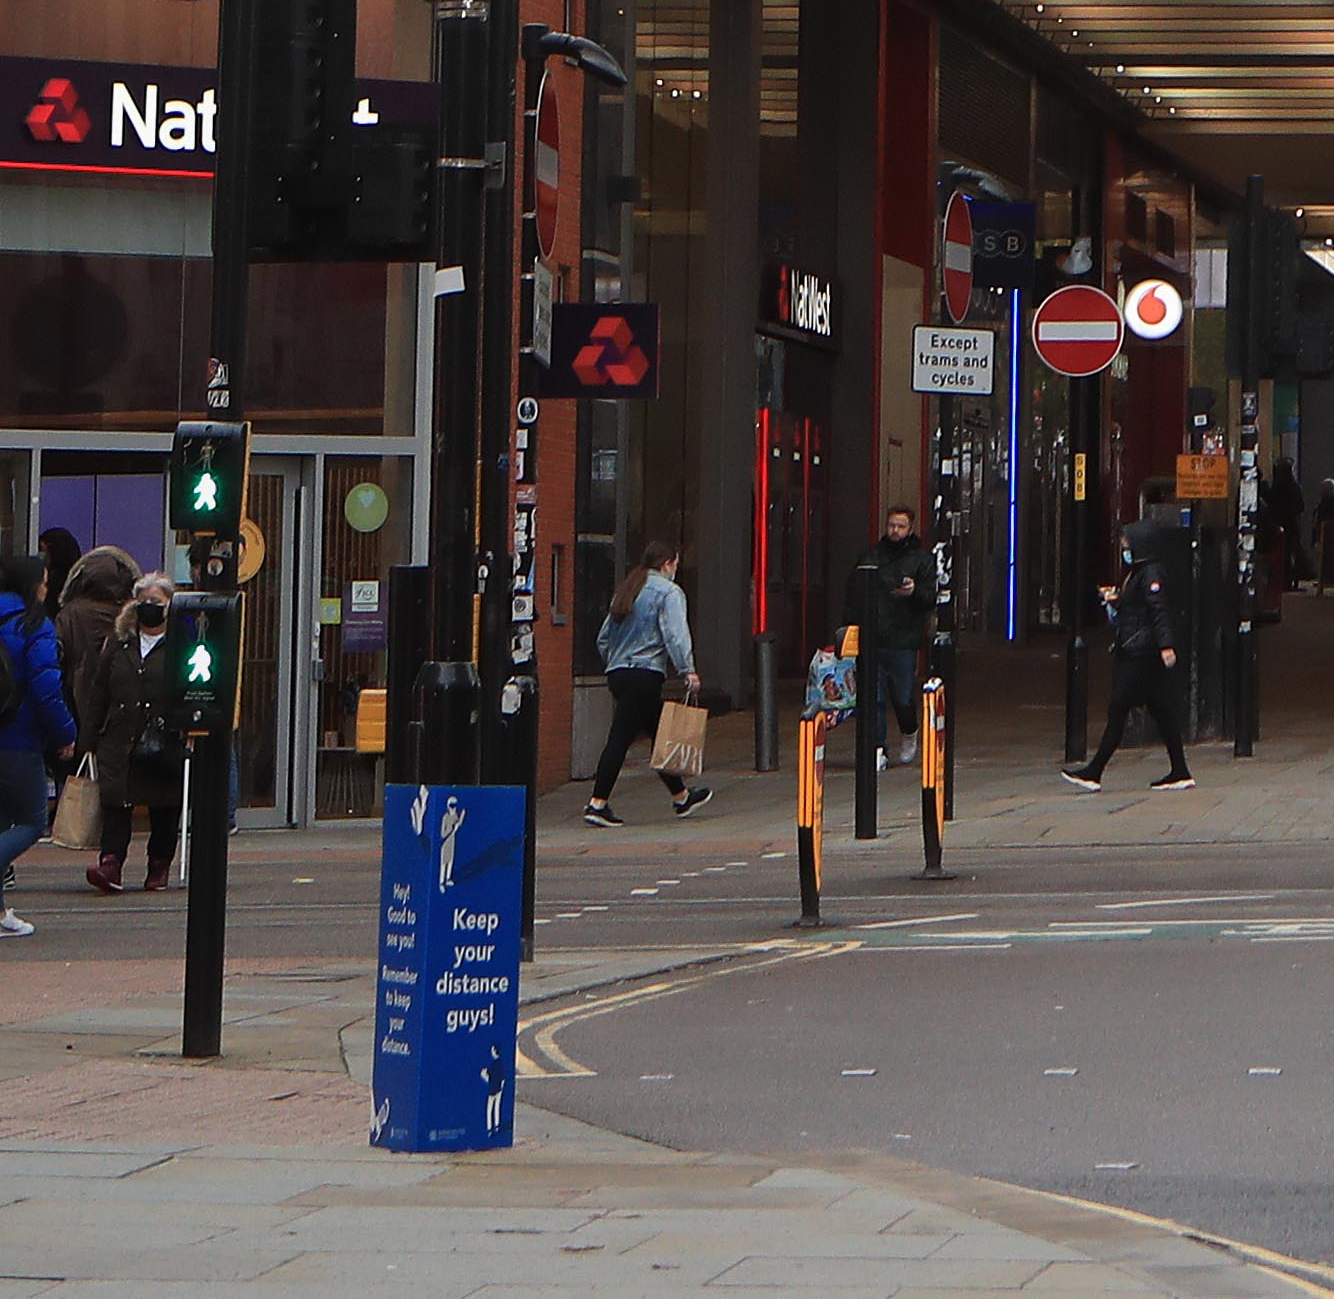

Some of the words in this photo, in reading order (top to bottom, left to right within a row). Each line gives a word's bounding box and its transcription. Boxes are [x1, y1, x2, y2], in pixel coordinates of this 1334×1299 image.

[790, 268, 831, 337] NatWest
[930, 334, 978, 351] Except
[919, 353, 959, 368] trams
[963, 355, 988, 369] and
[931, 371, 975, 386] cycles
[387, 905, 407, 925] Good
[408, 907, 417, 925] to
[453, 908, 499, 937] Keep
[453, 945, 496, 969] your
[382, 964, 418, 985] Remember
[436, 971, 509, 994] distance
[394, 990, 412, 1013] keep
[446, 1003, 495, 1033] guys!
